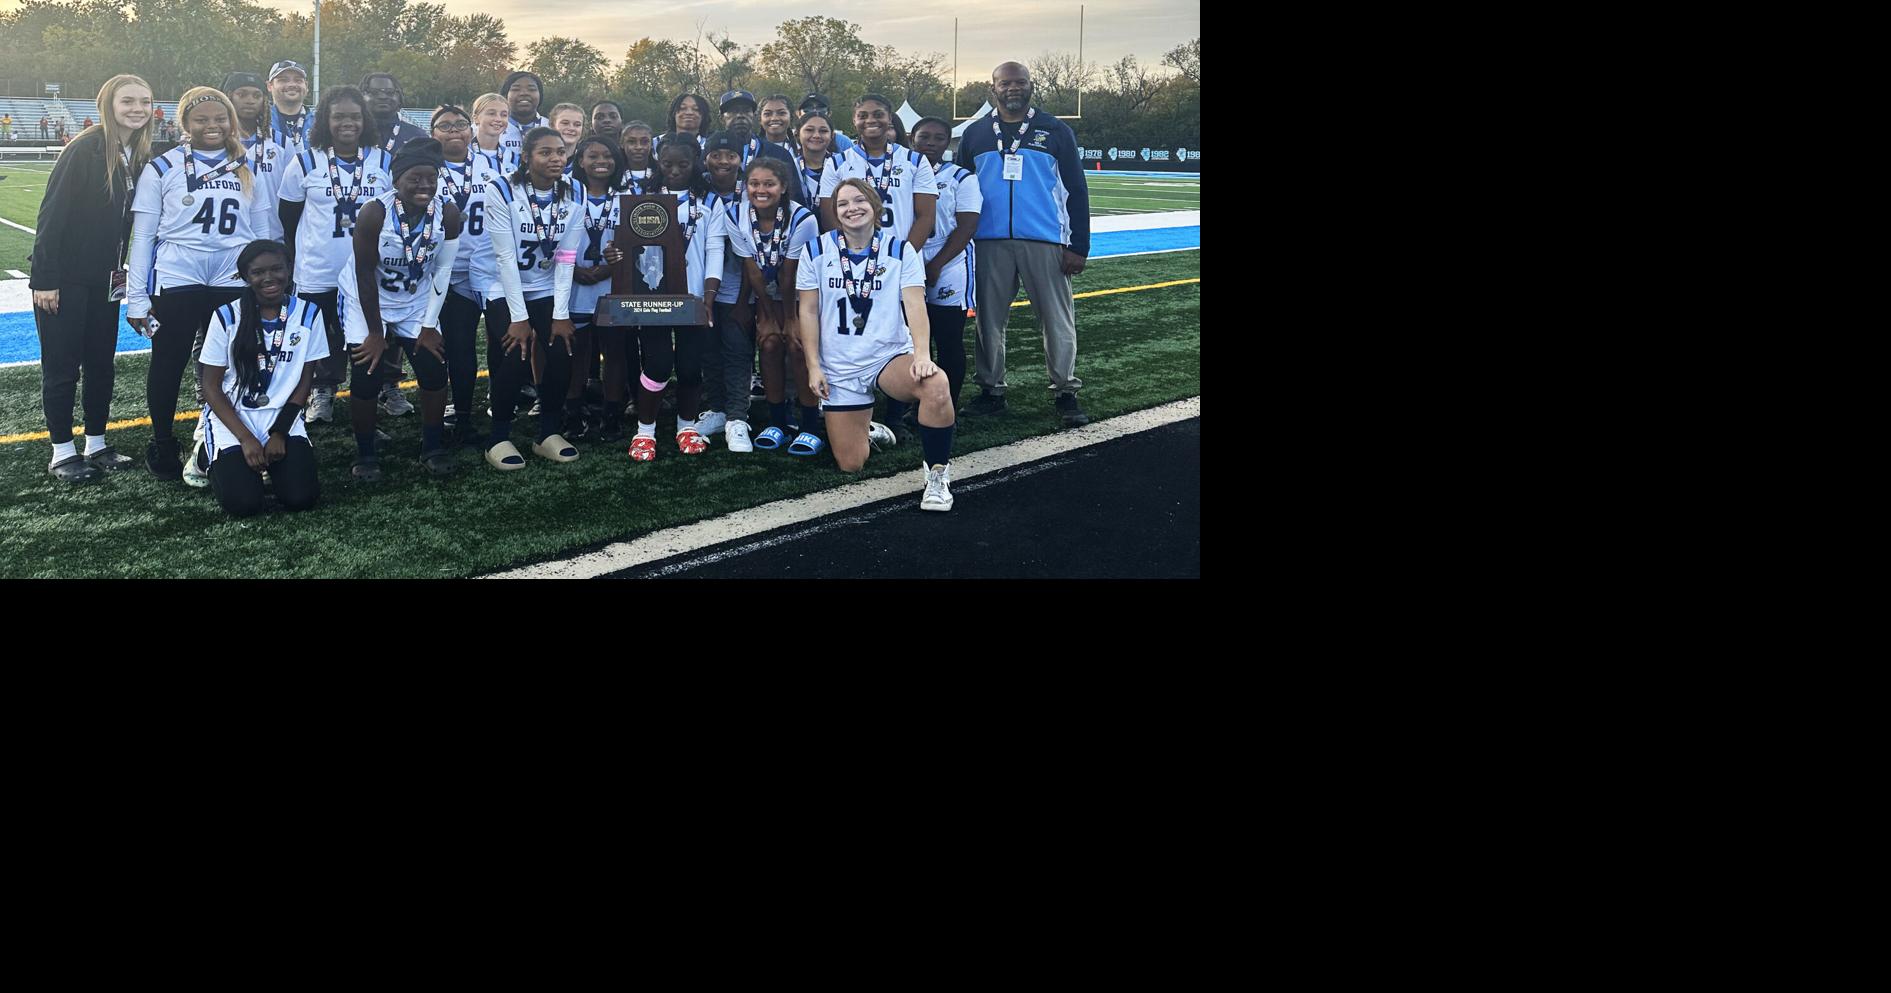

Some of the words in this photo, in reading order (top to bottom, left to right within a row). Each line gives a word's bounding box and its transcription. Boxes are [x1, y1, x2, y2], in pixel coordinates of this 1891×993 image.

[1085, 149, 1103, 157] 1978
[192, 197, 240, 236] 46
[333, 203, 363, 238] 1
[837, 297, 873, 336] 17
